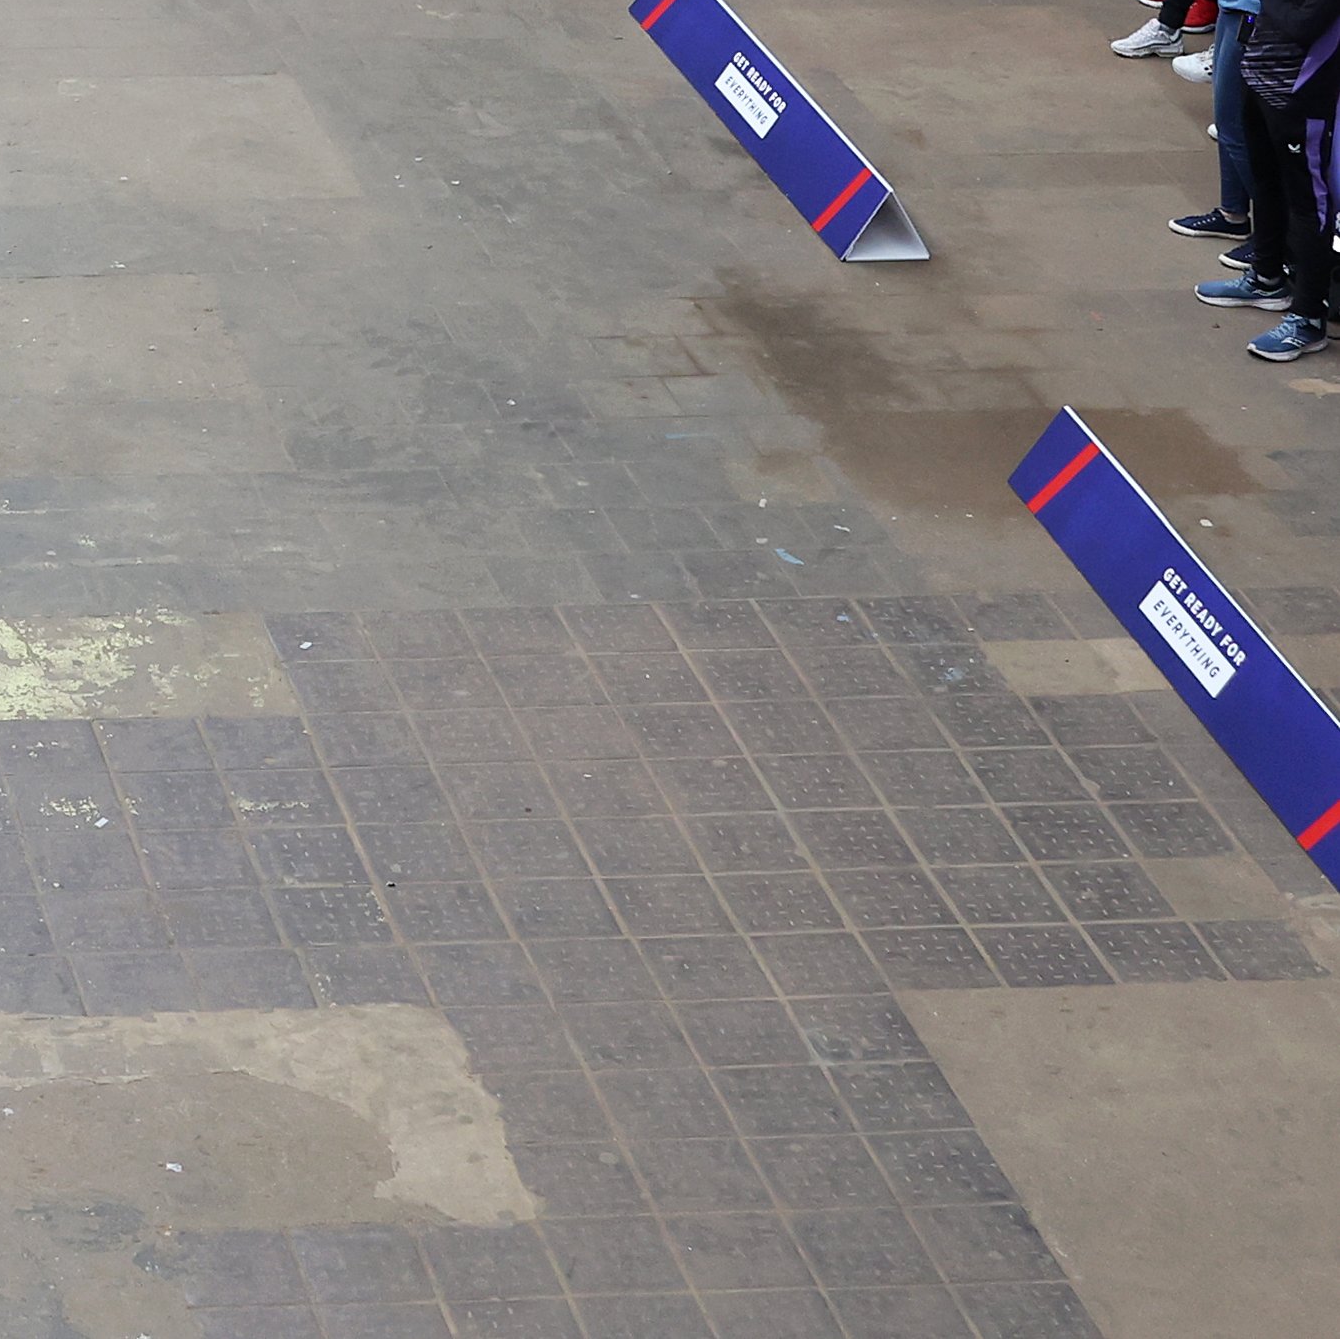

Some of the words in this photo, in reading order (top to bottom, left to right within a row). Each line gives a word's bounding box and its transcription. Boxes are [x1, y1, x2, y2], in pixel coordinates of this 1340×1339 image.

[725, 76, 768, 125] EVERYTHING
[733, 51, 750, 71] GET
[746, 66, 773, 96] READY
[768, 91, 787, 114] FOR
[1153, 599, 1220, 678] EVERYTHING
[1163, 567, 1188, 595] GET
[1183, 592, 1223, 637] READY
[1219, 634, 1247, 667] FOR
